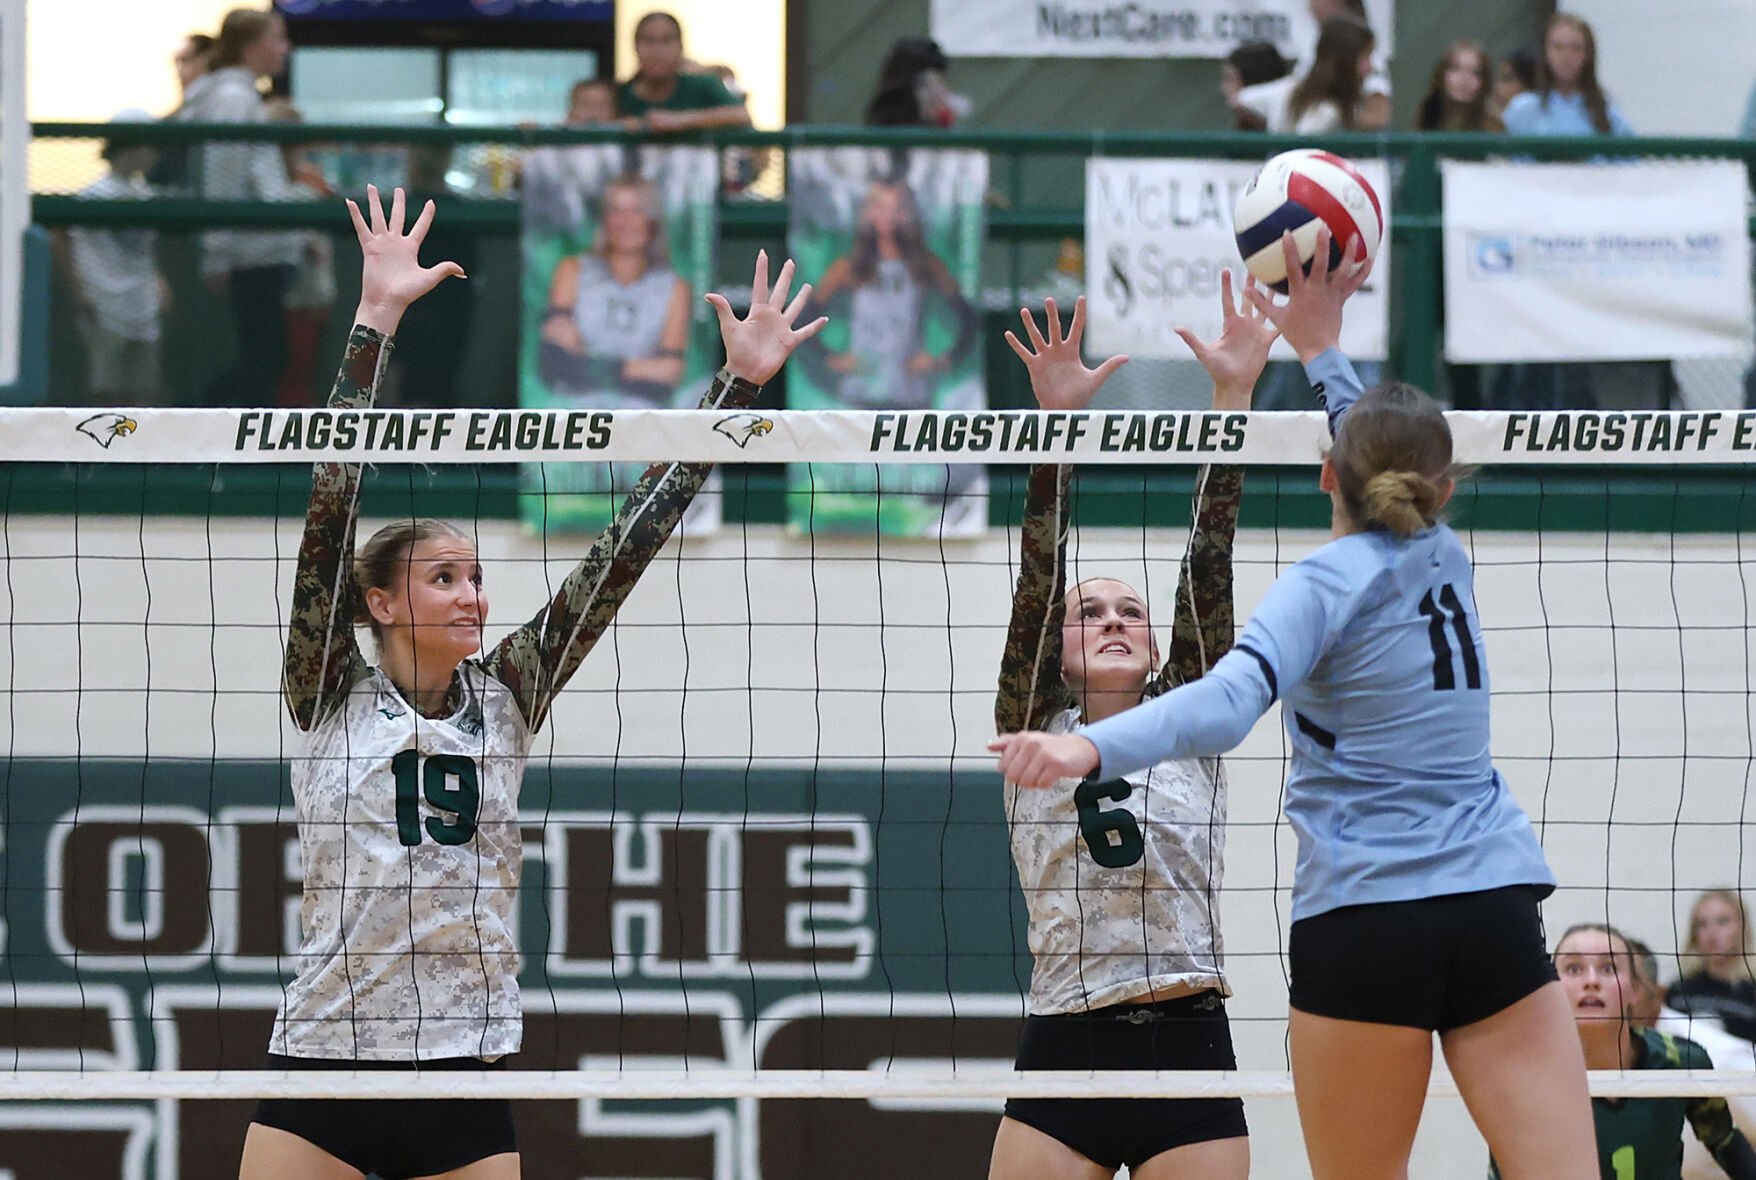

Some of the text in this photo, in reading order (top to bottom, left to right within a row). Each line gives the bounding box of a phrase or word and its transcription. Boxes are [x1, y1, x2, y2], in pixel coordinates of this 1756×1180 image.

[235, 412, 613, 451] FLAGSTAFF EAGLES
[870, 414, 1248, 452] FLAGSTAFF EAGLES
[1503, 413, 1756, 451] FLAGSTAFF E
[1419, 583, 1481, 691] 11
[391, 749, 480, 846] 19
[1074, 776, 1145, 869] 6
[519, 811, 875, 980] HE
